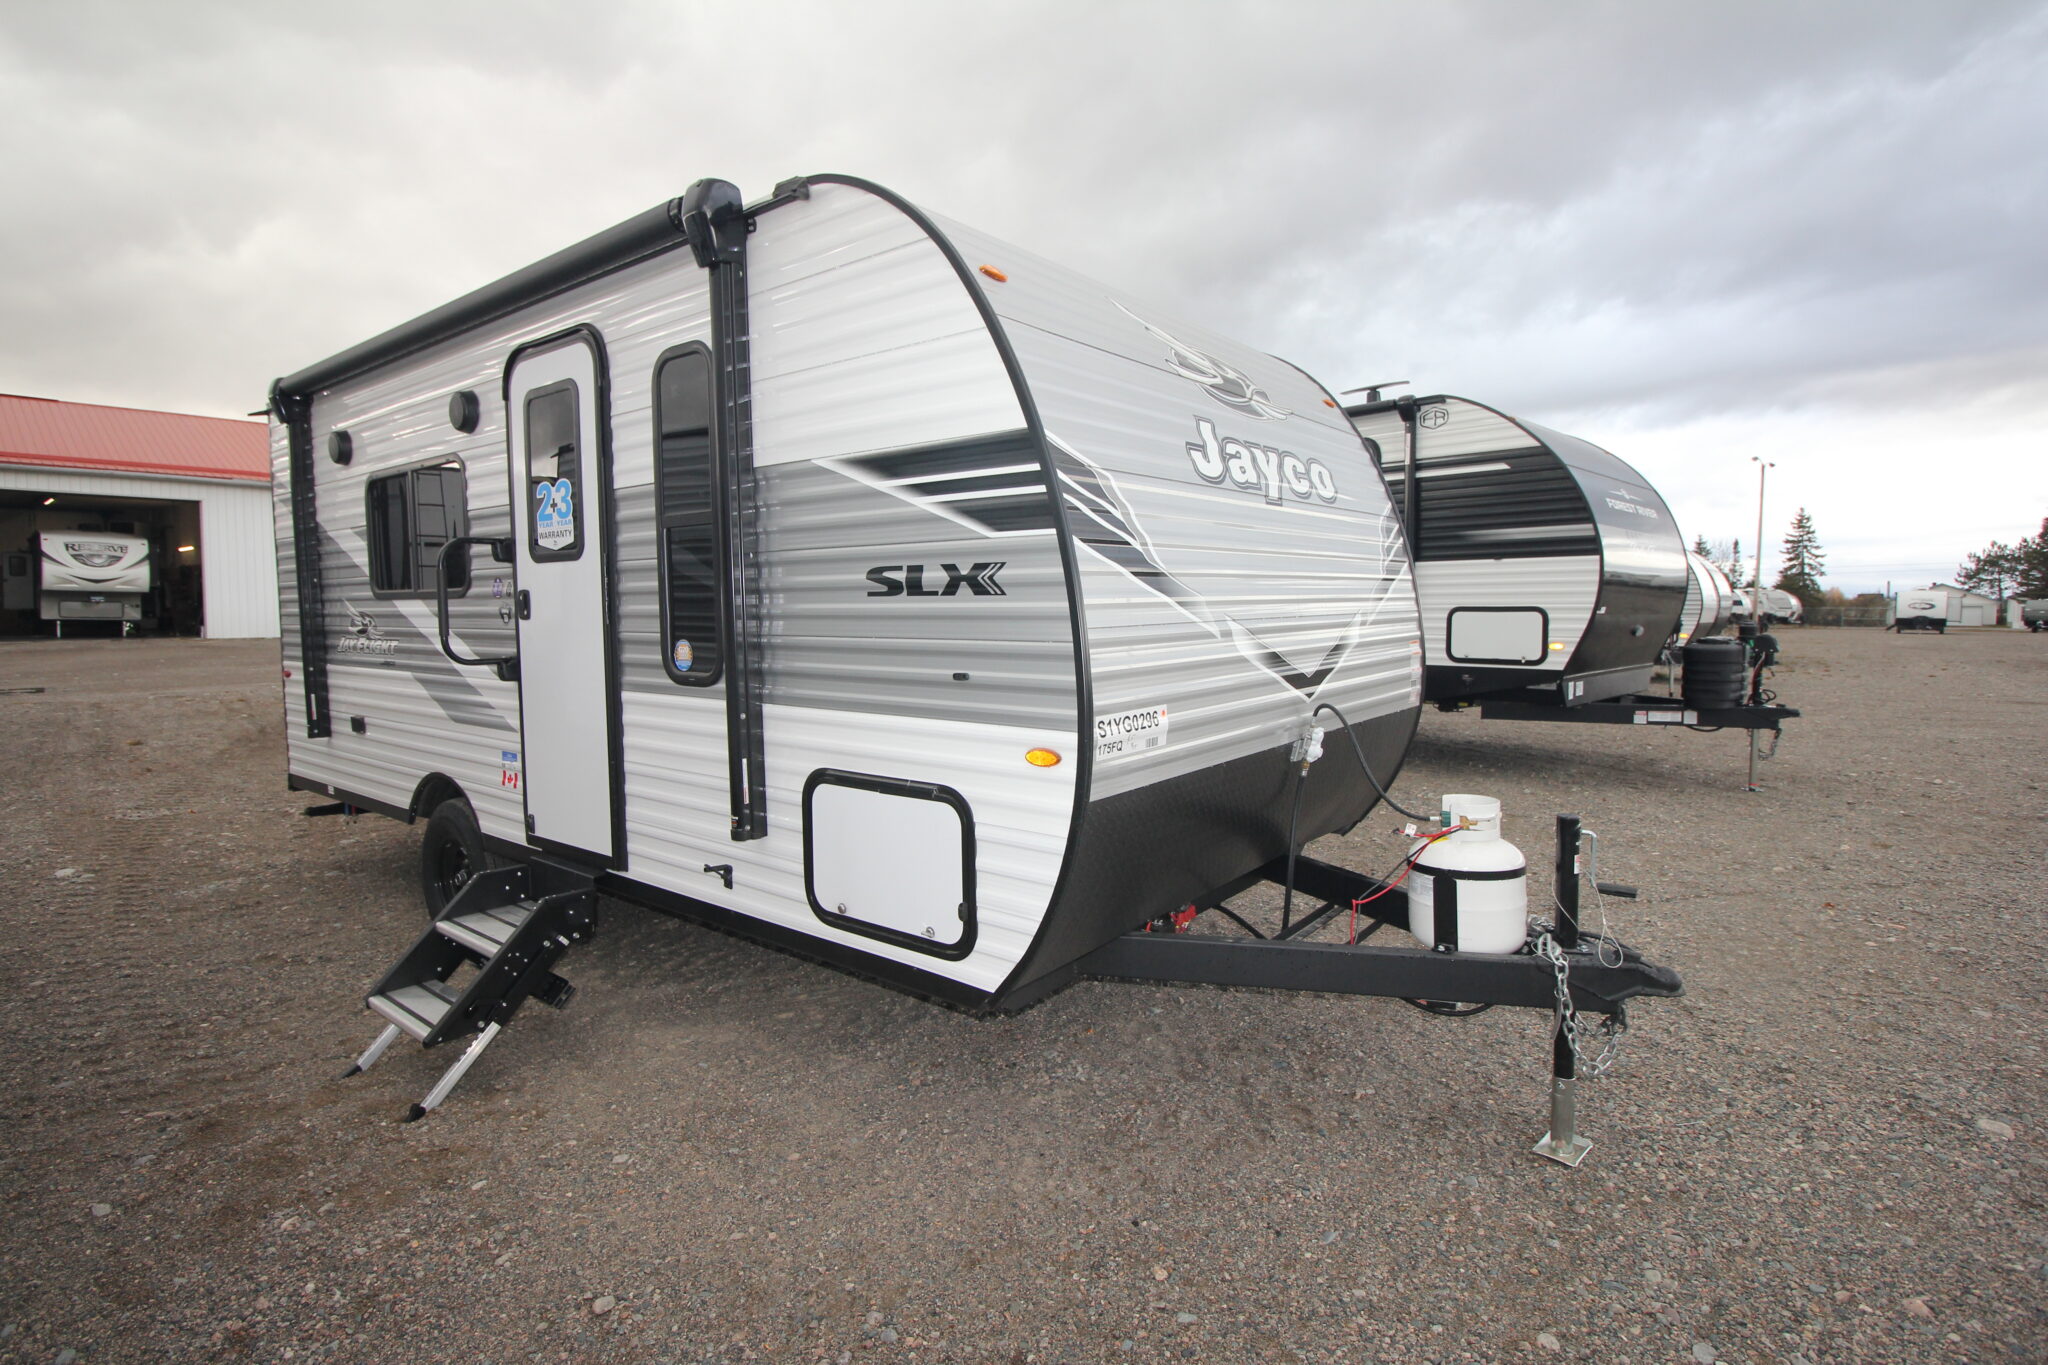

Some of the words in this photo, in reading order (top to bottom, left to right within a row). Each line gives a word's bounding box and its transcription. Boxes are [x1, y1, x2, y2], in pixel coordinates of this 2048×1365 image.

[1185, 415, 1337, 506] Jayco
[539, 529, 572, 540] WARRANTY
[866, 562, 1007, 597] SLX
[337, 636, 359, 654] JAY
[358, 637, 399, 655] FLIGHT
[1097, 710, 1159, 738] S1YG0296
[1098, 740, 1123, 756] 175FQ
